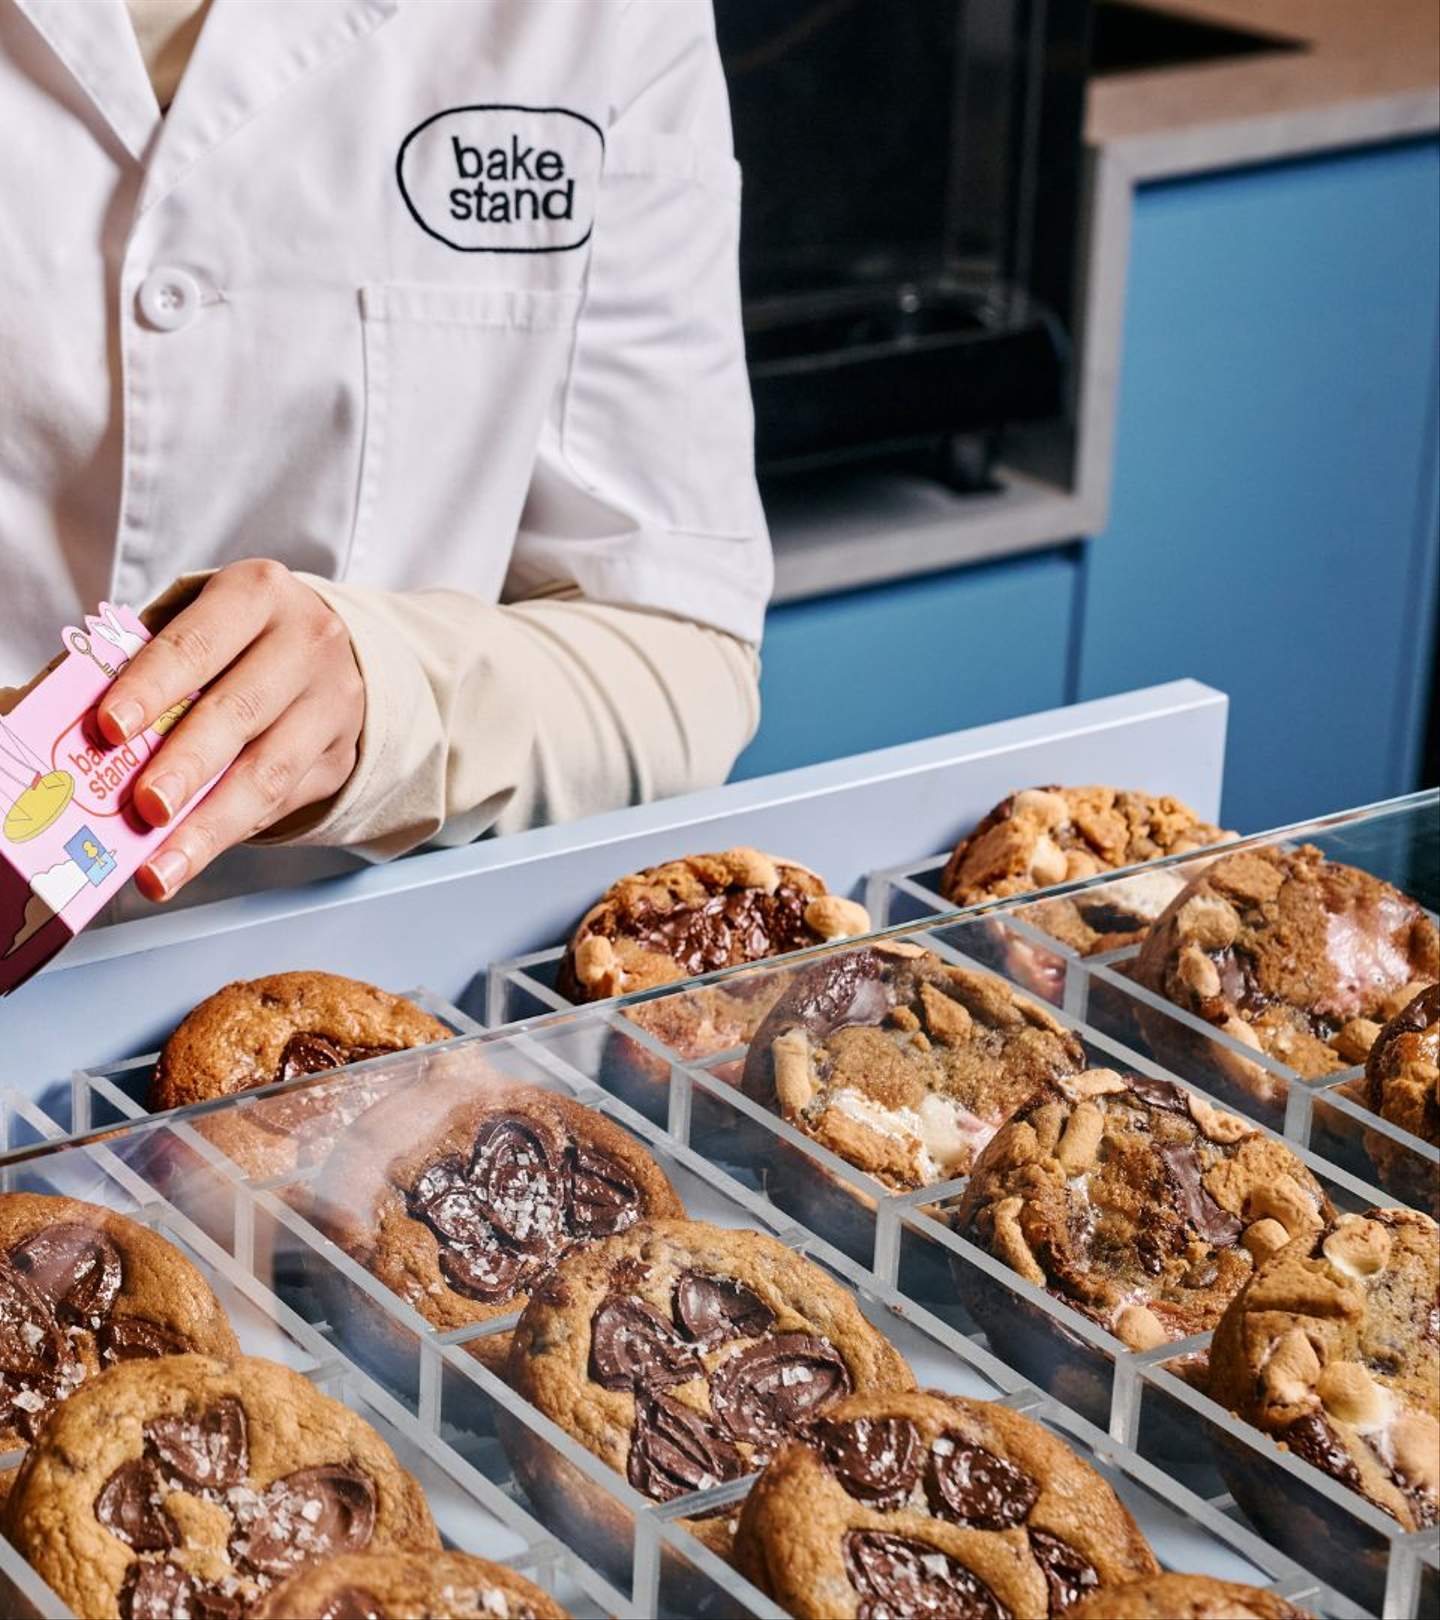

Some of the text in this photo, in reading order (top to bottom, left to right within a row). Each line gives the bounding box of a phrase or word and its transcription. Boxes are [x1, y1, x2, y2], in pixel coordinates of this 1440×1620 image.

[451, 134, 564, 182] bake
[449, 179, 574, 223] stand
[89, 748, 141, 801] stand
